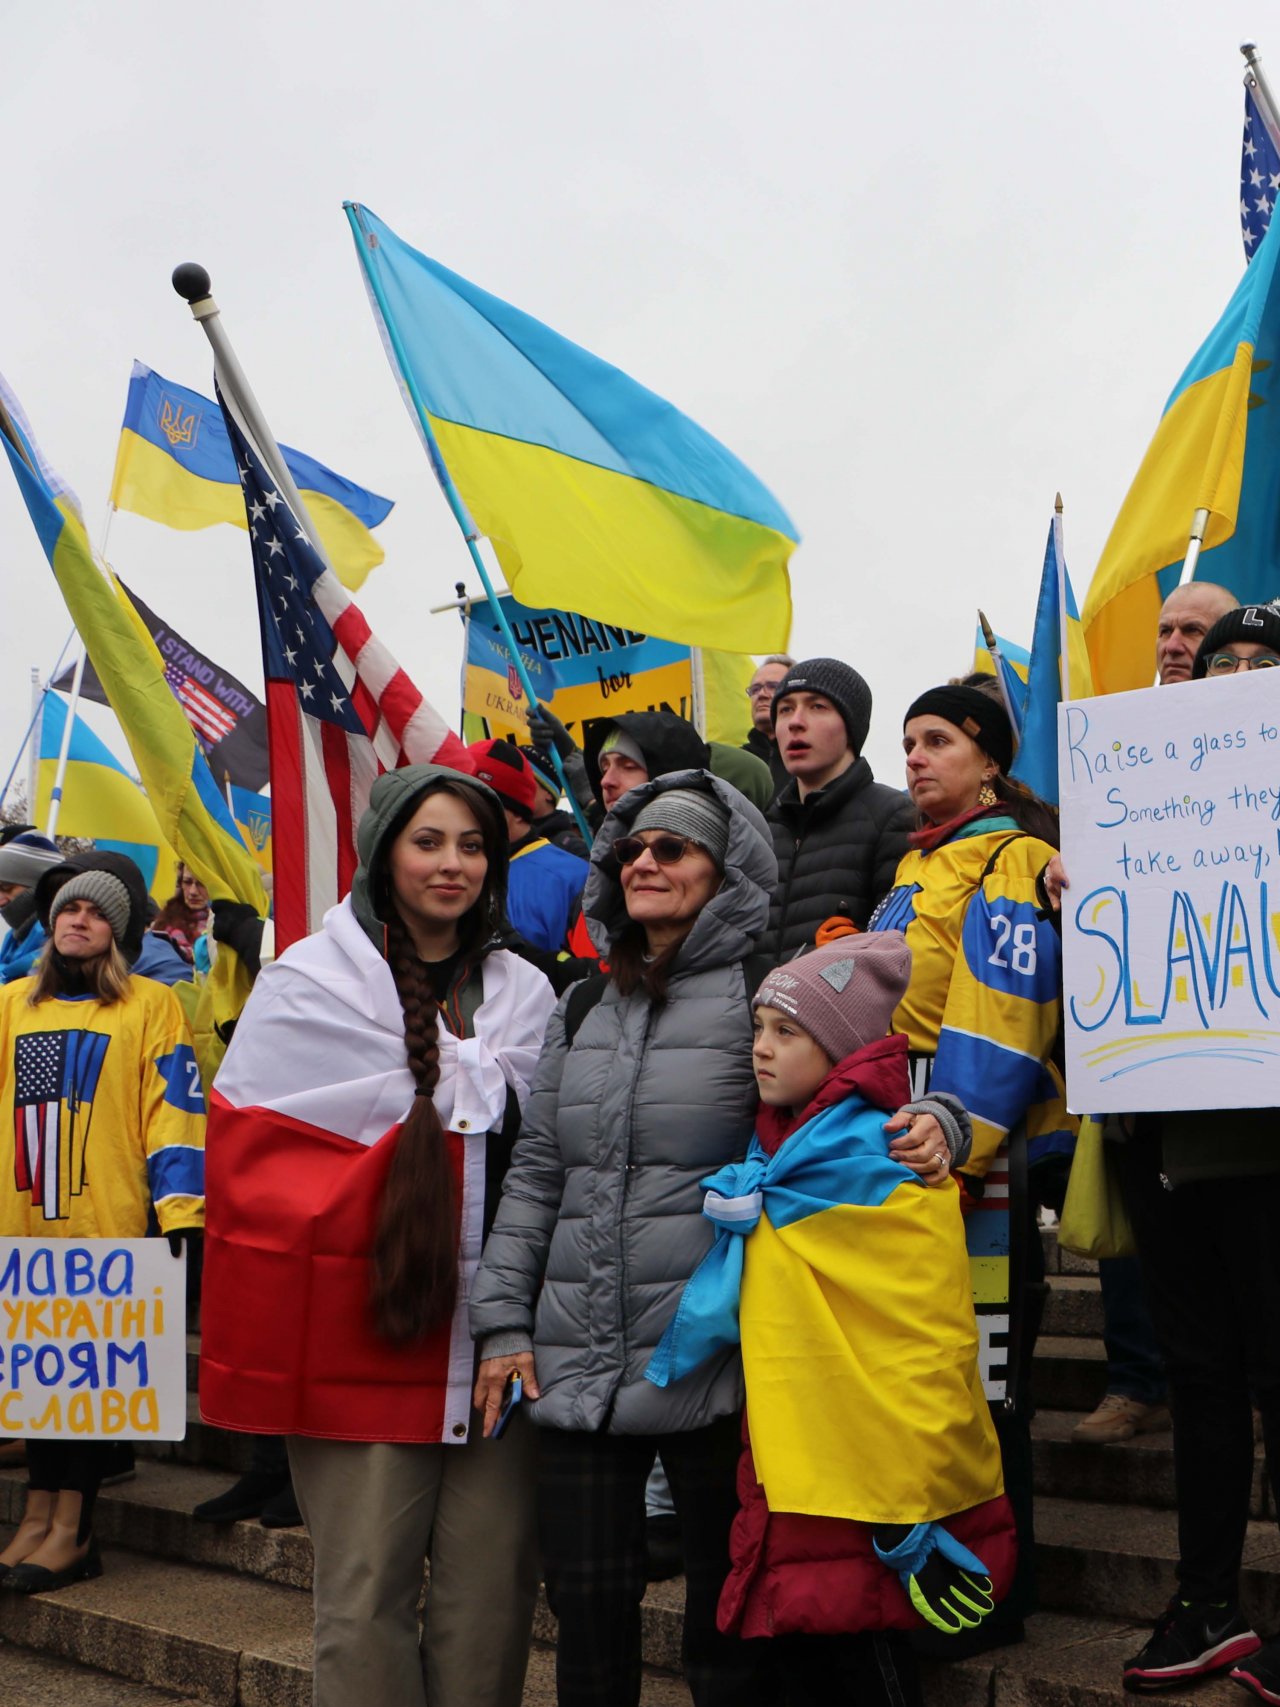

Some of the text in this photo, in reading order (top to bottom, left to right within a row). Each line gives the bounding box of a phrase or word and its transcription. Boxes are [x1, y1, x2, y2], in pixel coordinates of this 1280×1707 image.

[160, 637, 216, 686] STAND
[213, 677, 256, 718] WITH
[1066, 707, 1154, 785] Raise
[1164, 741, 1180, 760] a
[1189, 730, 1247, 772] glass
[1258, 722, 1278, 743] to
[1118, 841, 1182, 881] take
[987, 914, 1037, 976] 28
